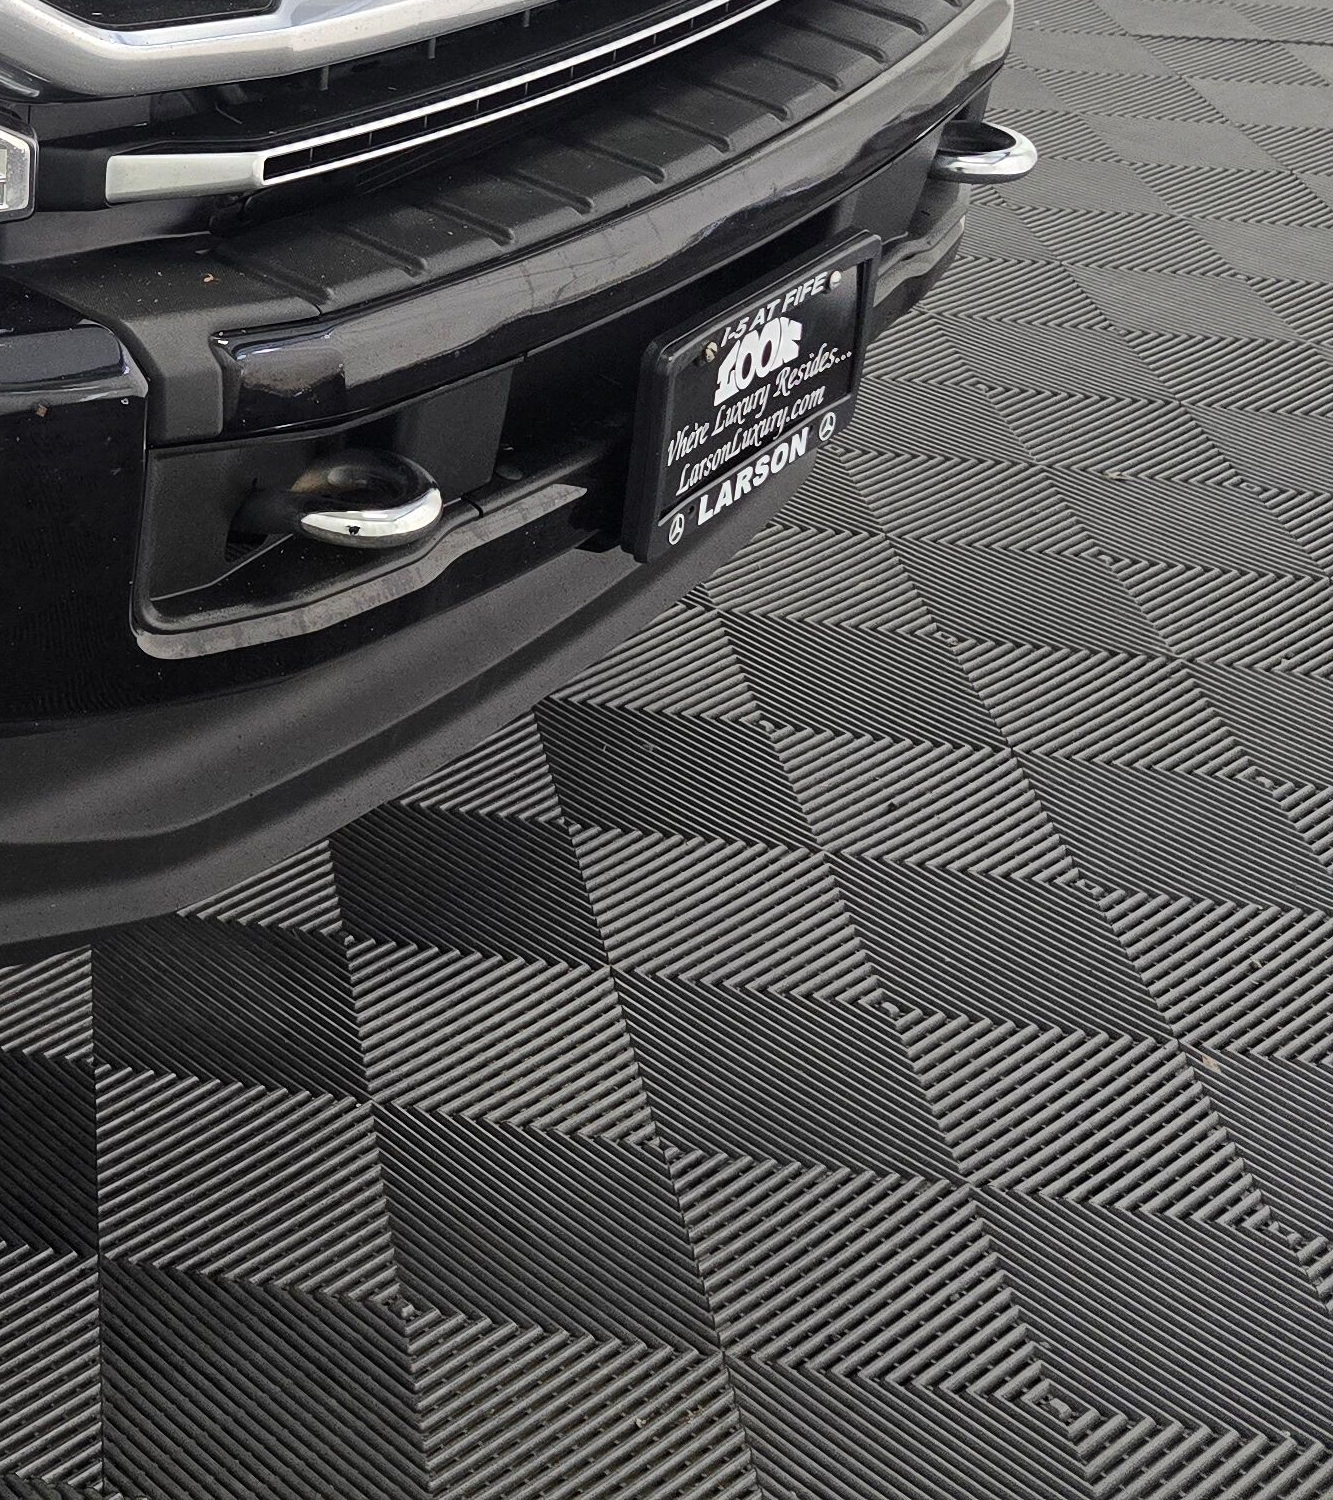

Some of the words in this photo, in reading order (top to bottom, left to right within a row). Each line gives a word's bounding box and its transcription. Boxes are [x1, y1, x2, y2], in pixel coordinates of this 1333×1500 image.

[720, 316, 750, 348] I-5
[748, 298, 781, 332] AT
[781, 271, 828, 313] FIFE
[675, 385, 826, 497] LarsonLuxury.com
[710, 383, 771, 437] Luxury
[697, 426, 810, 526] LARSON
